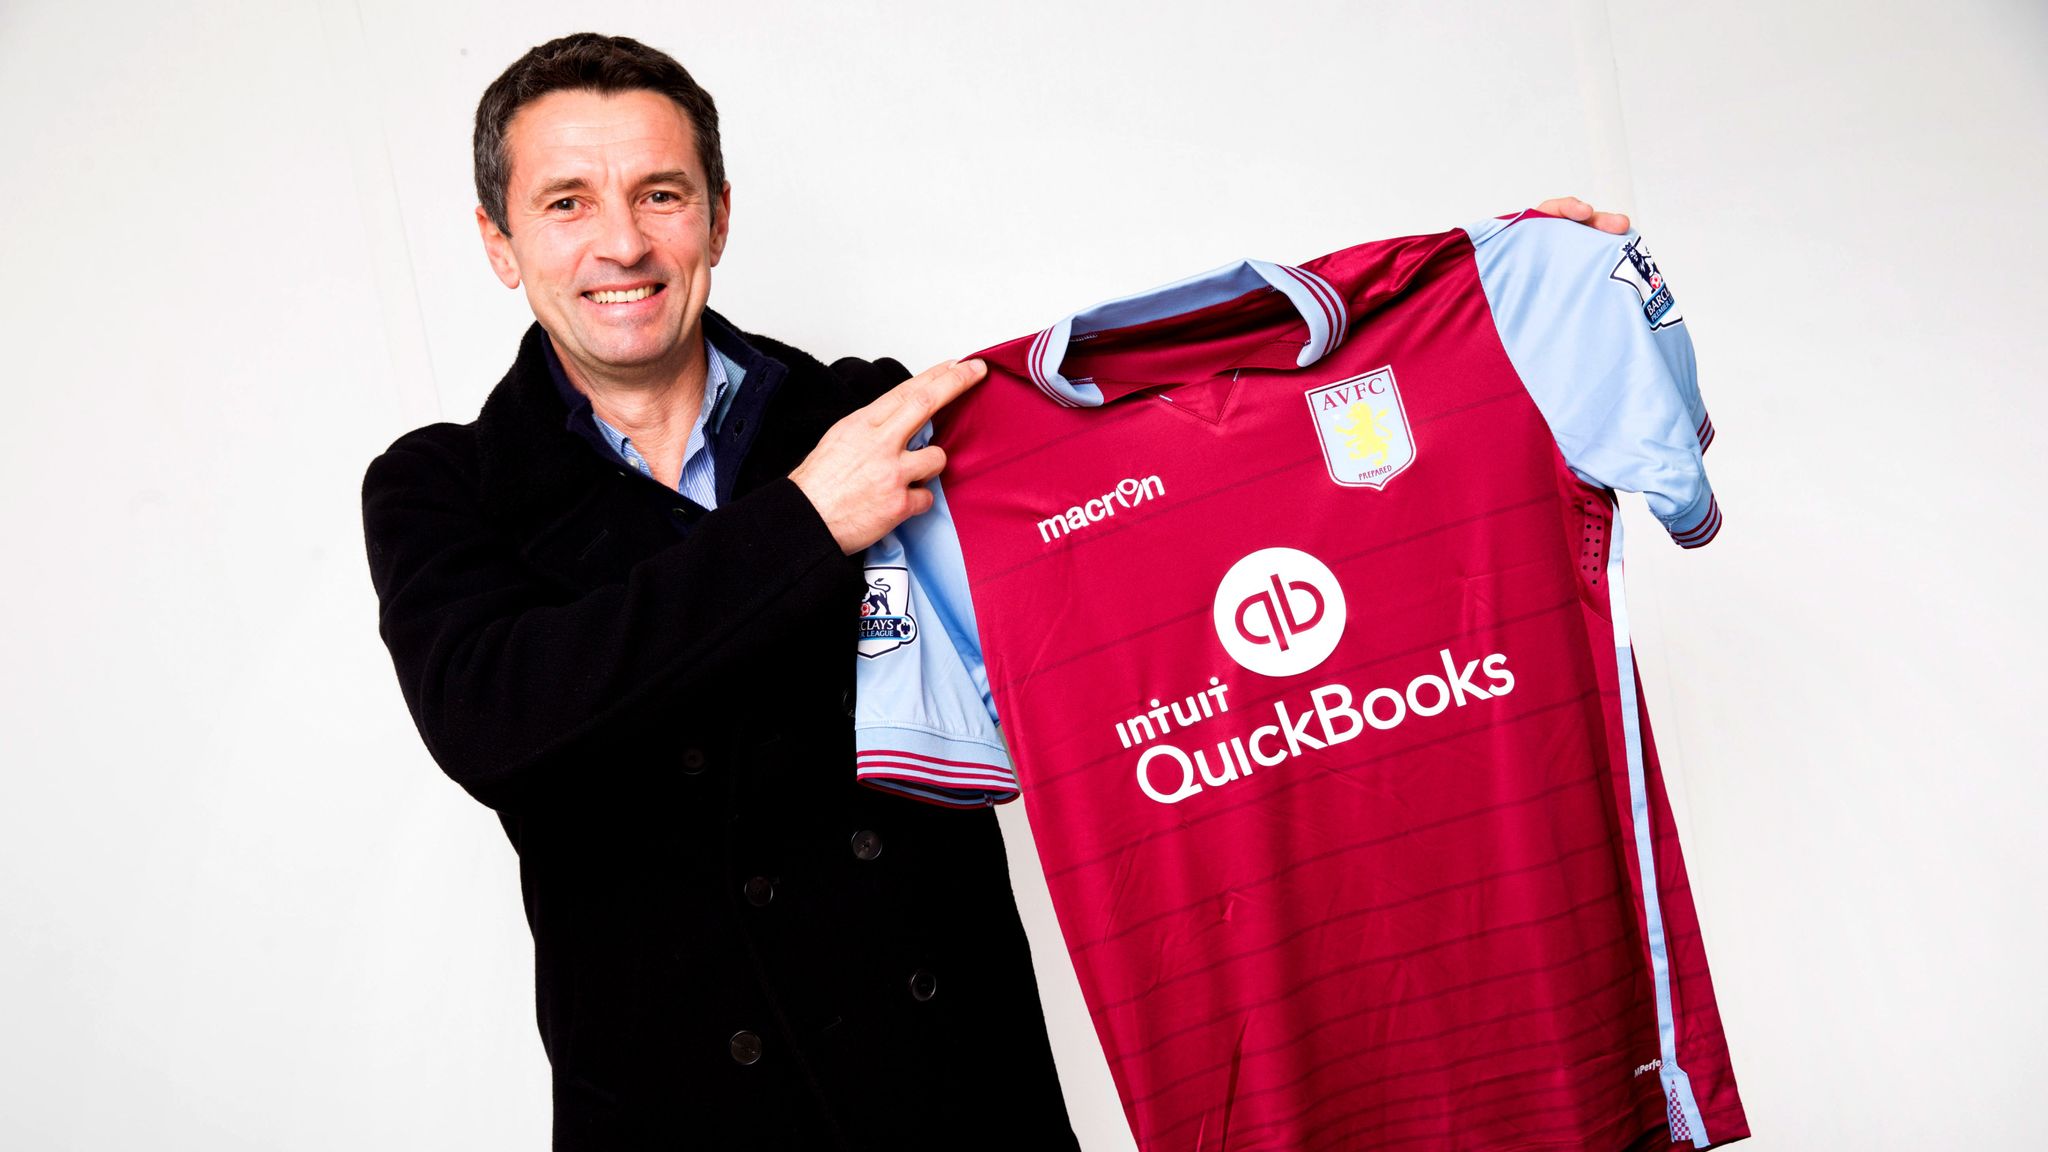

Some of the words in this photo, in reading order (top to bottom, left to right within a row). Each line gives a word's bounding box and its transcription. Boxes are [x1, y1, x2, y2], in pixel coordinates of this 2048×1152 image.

[1646, 288, 1671, 316] BARCL
[1323, 377, 1386, 411] AVFC
[1358, 464, 1393, 481] PREPARED
[1037, 475, 1166, 543] macron
[859, 619, 894, 631] CLAYS
[1136, 648, 1515, 805] QuickBooks
